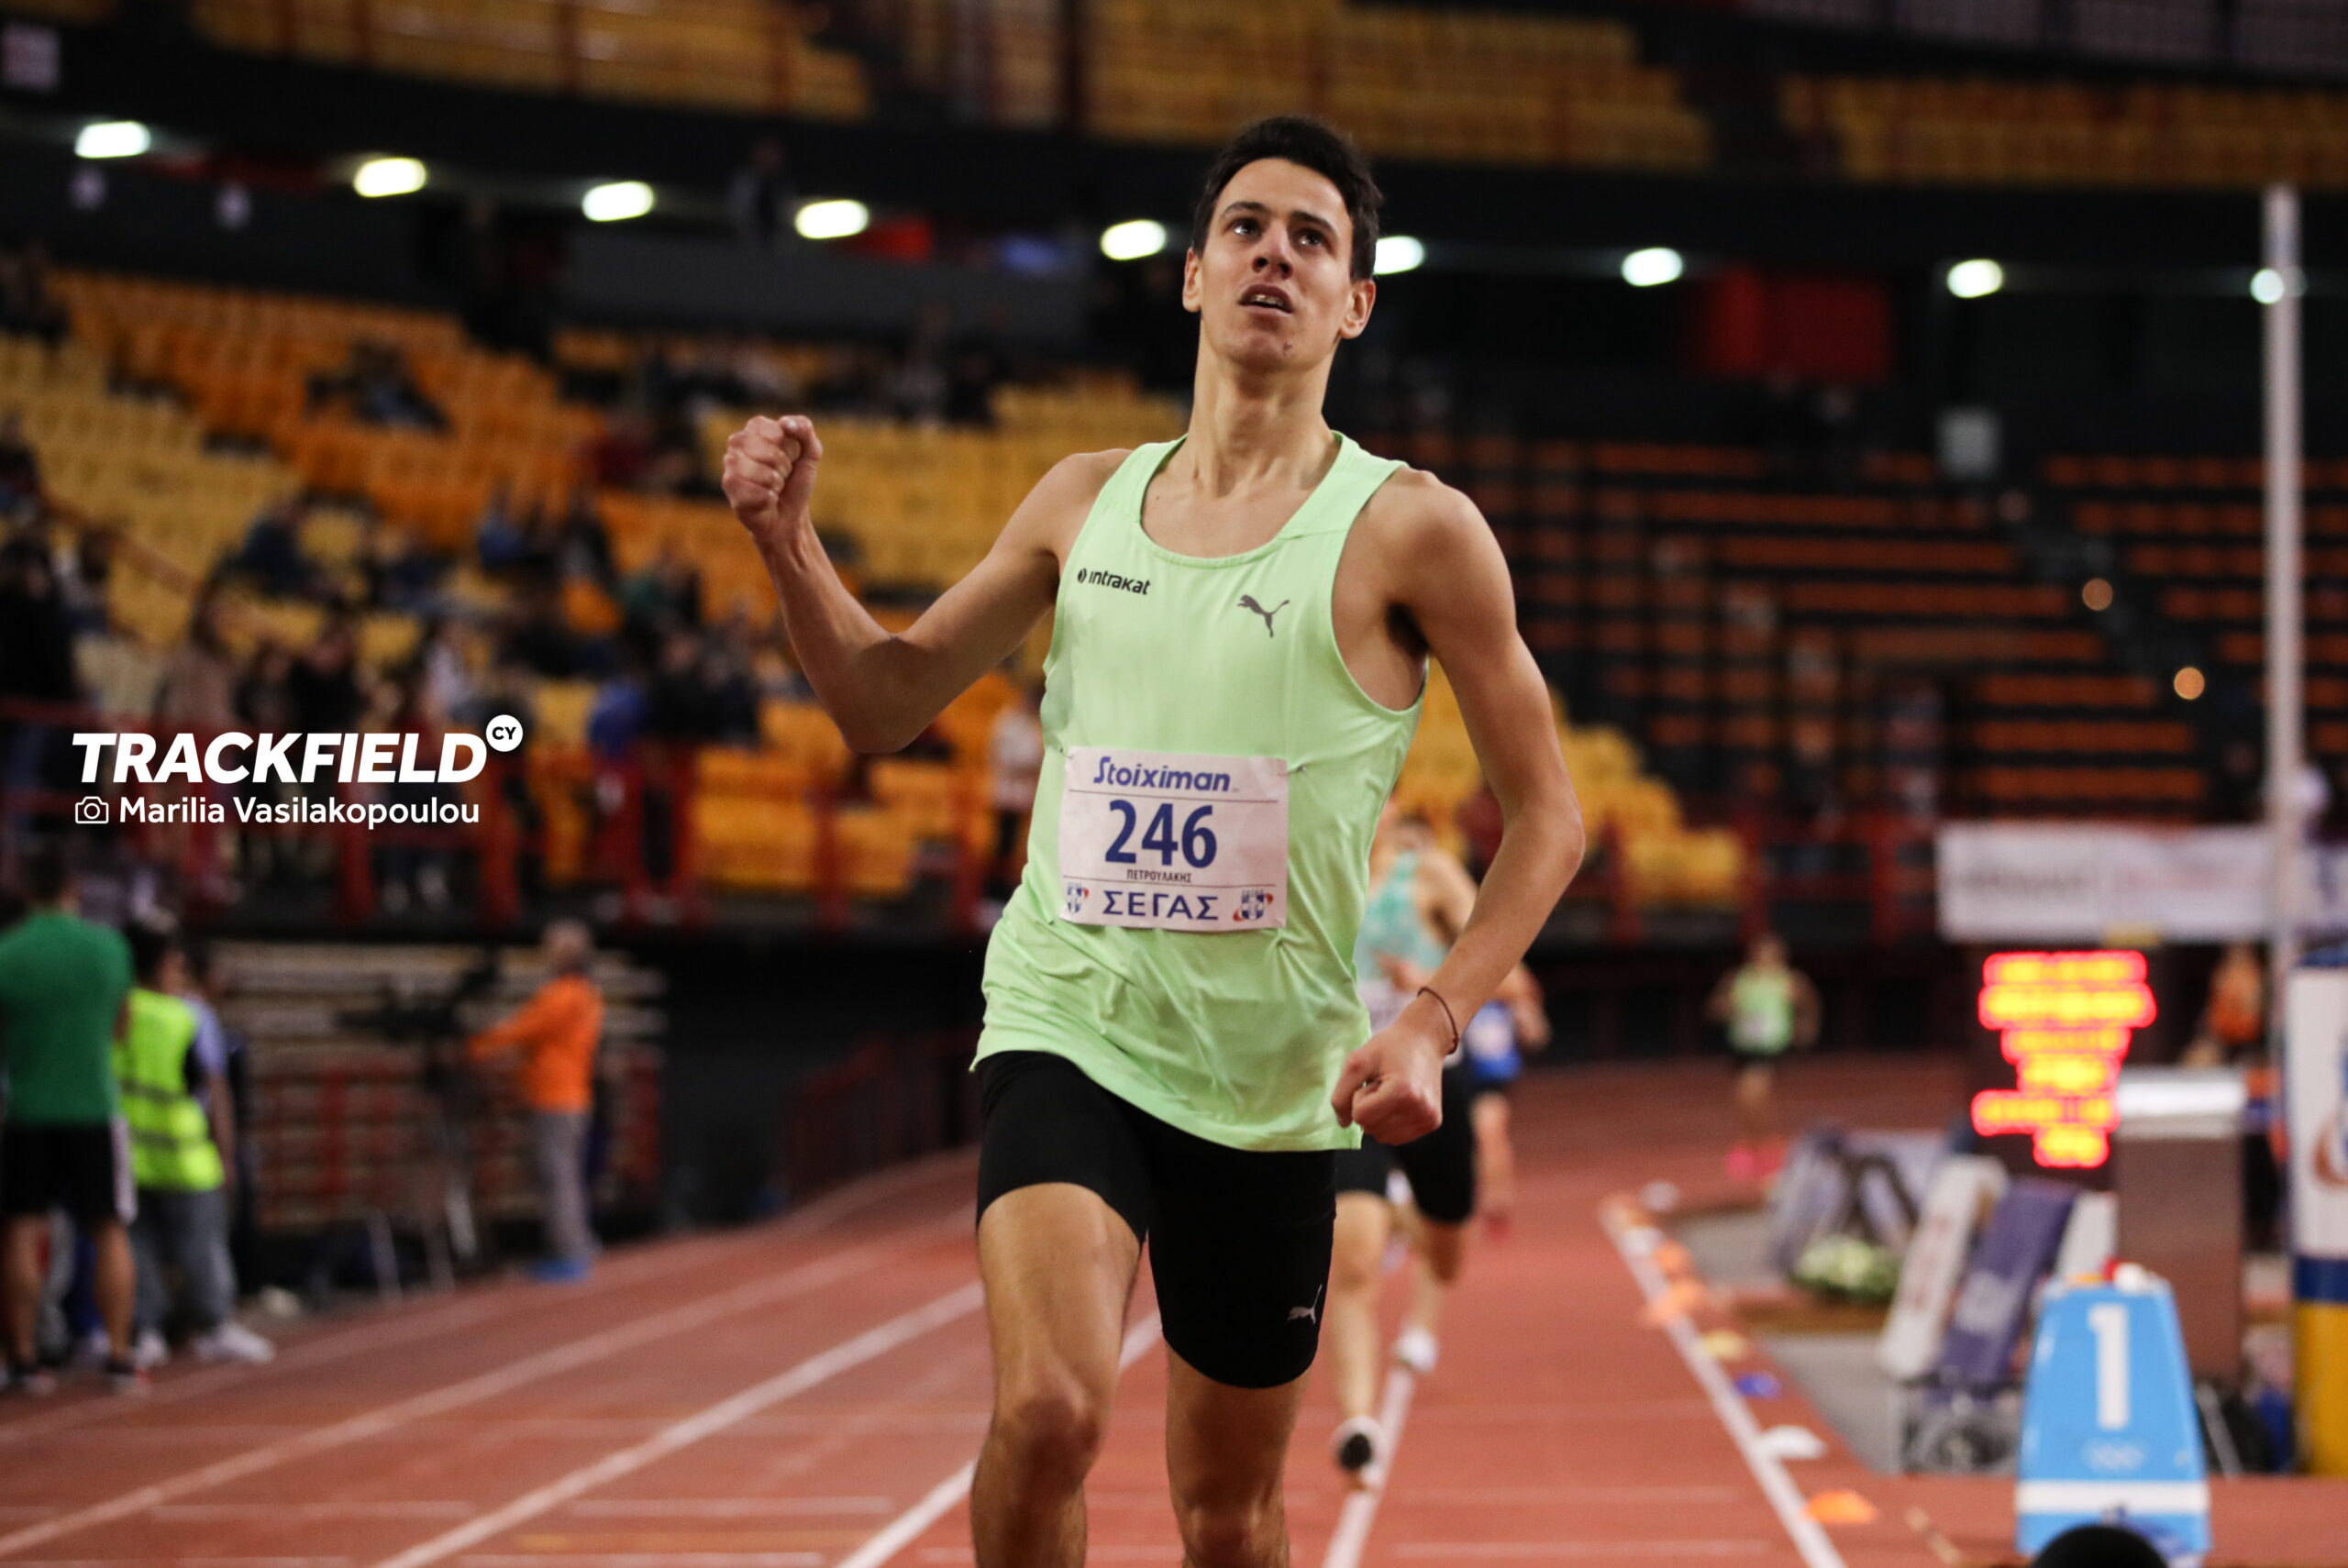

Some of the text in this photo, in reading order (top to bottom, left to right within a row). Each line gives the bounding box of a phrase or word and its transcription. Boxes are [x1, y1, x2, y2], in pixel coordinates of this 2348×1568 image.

[1093, 756, 1231, 792] Stoiximan
[1105, 800, 1217, 868] 246
[1126, 869, 1192, 883] ΠΕΤΡΟΥΛΑΚΗΣ
[1102, 890, 1219, 921] ΣΕΓΑΣ
[2088, 1303, 2131, 1430] 1
